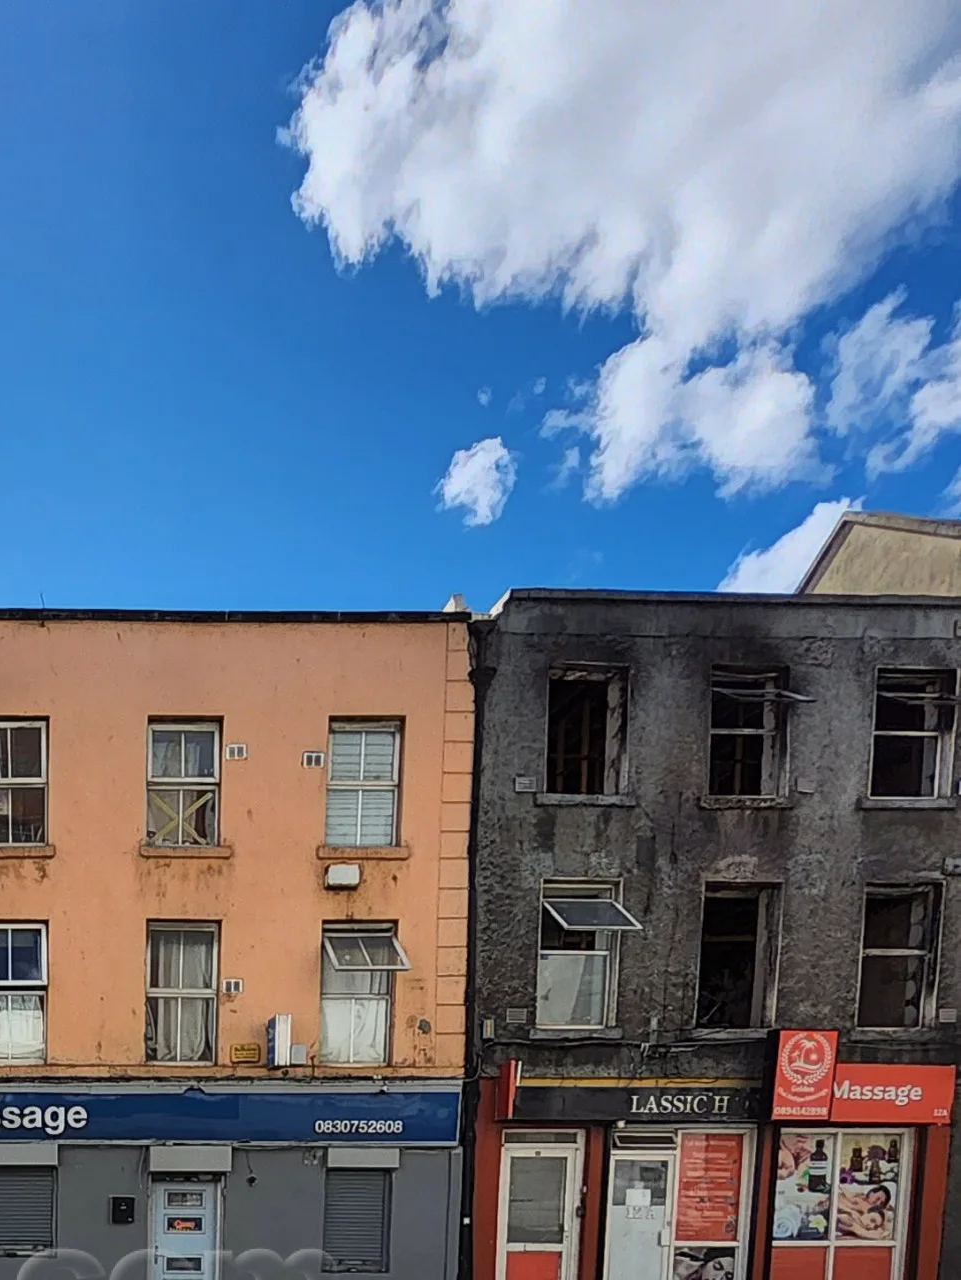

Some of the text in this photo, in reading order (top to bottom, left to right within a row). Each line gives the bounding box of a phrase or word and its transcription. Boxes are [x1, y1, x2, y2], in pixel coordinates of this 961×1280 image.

[833, 1080, 923, 1106] Massage
[630, 1095, 708, 1114] LASSIC
[314, 1120, 404, 1134] 0830752608
